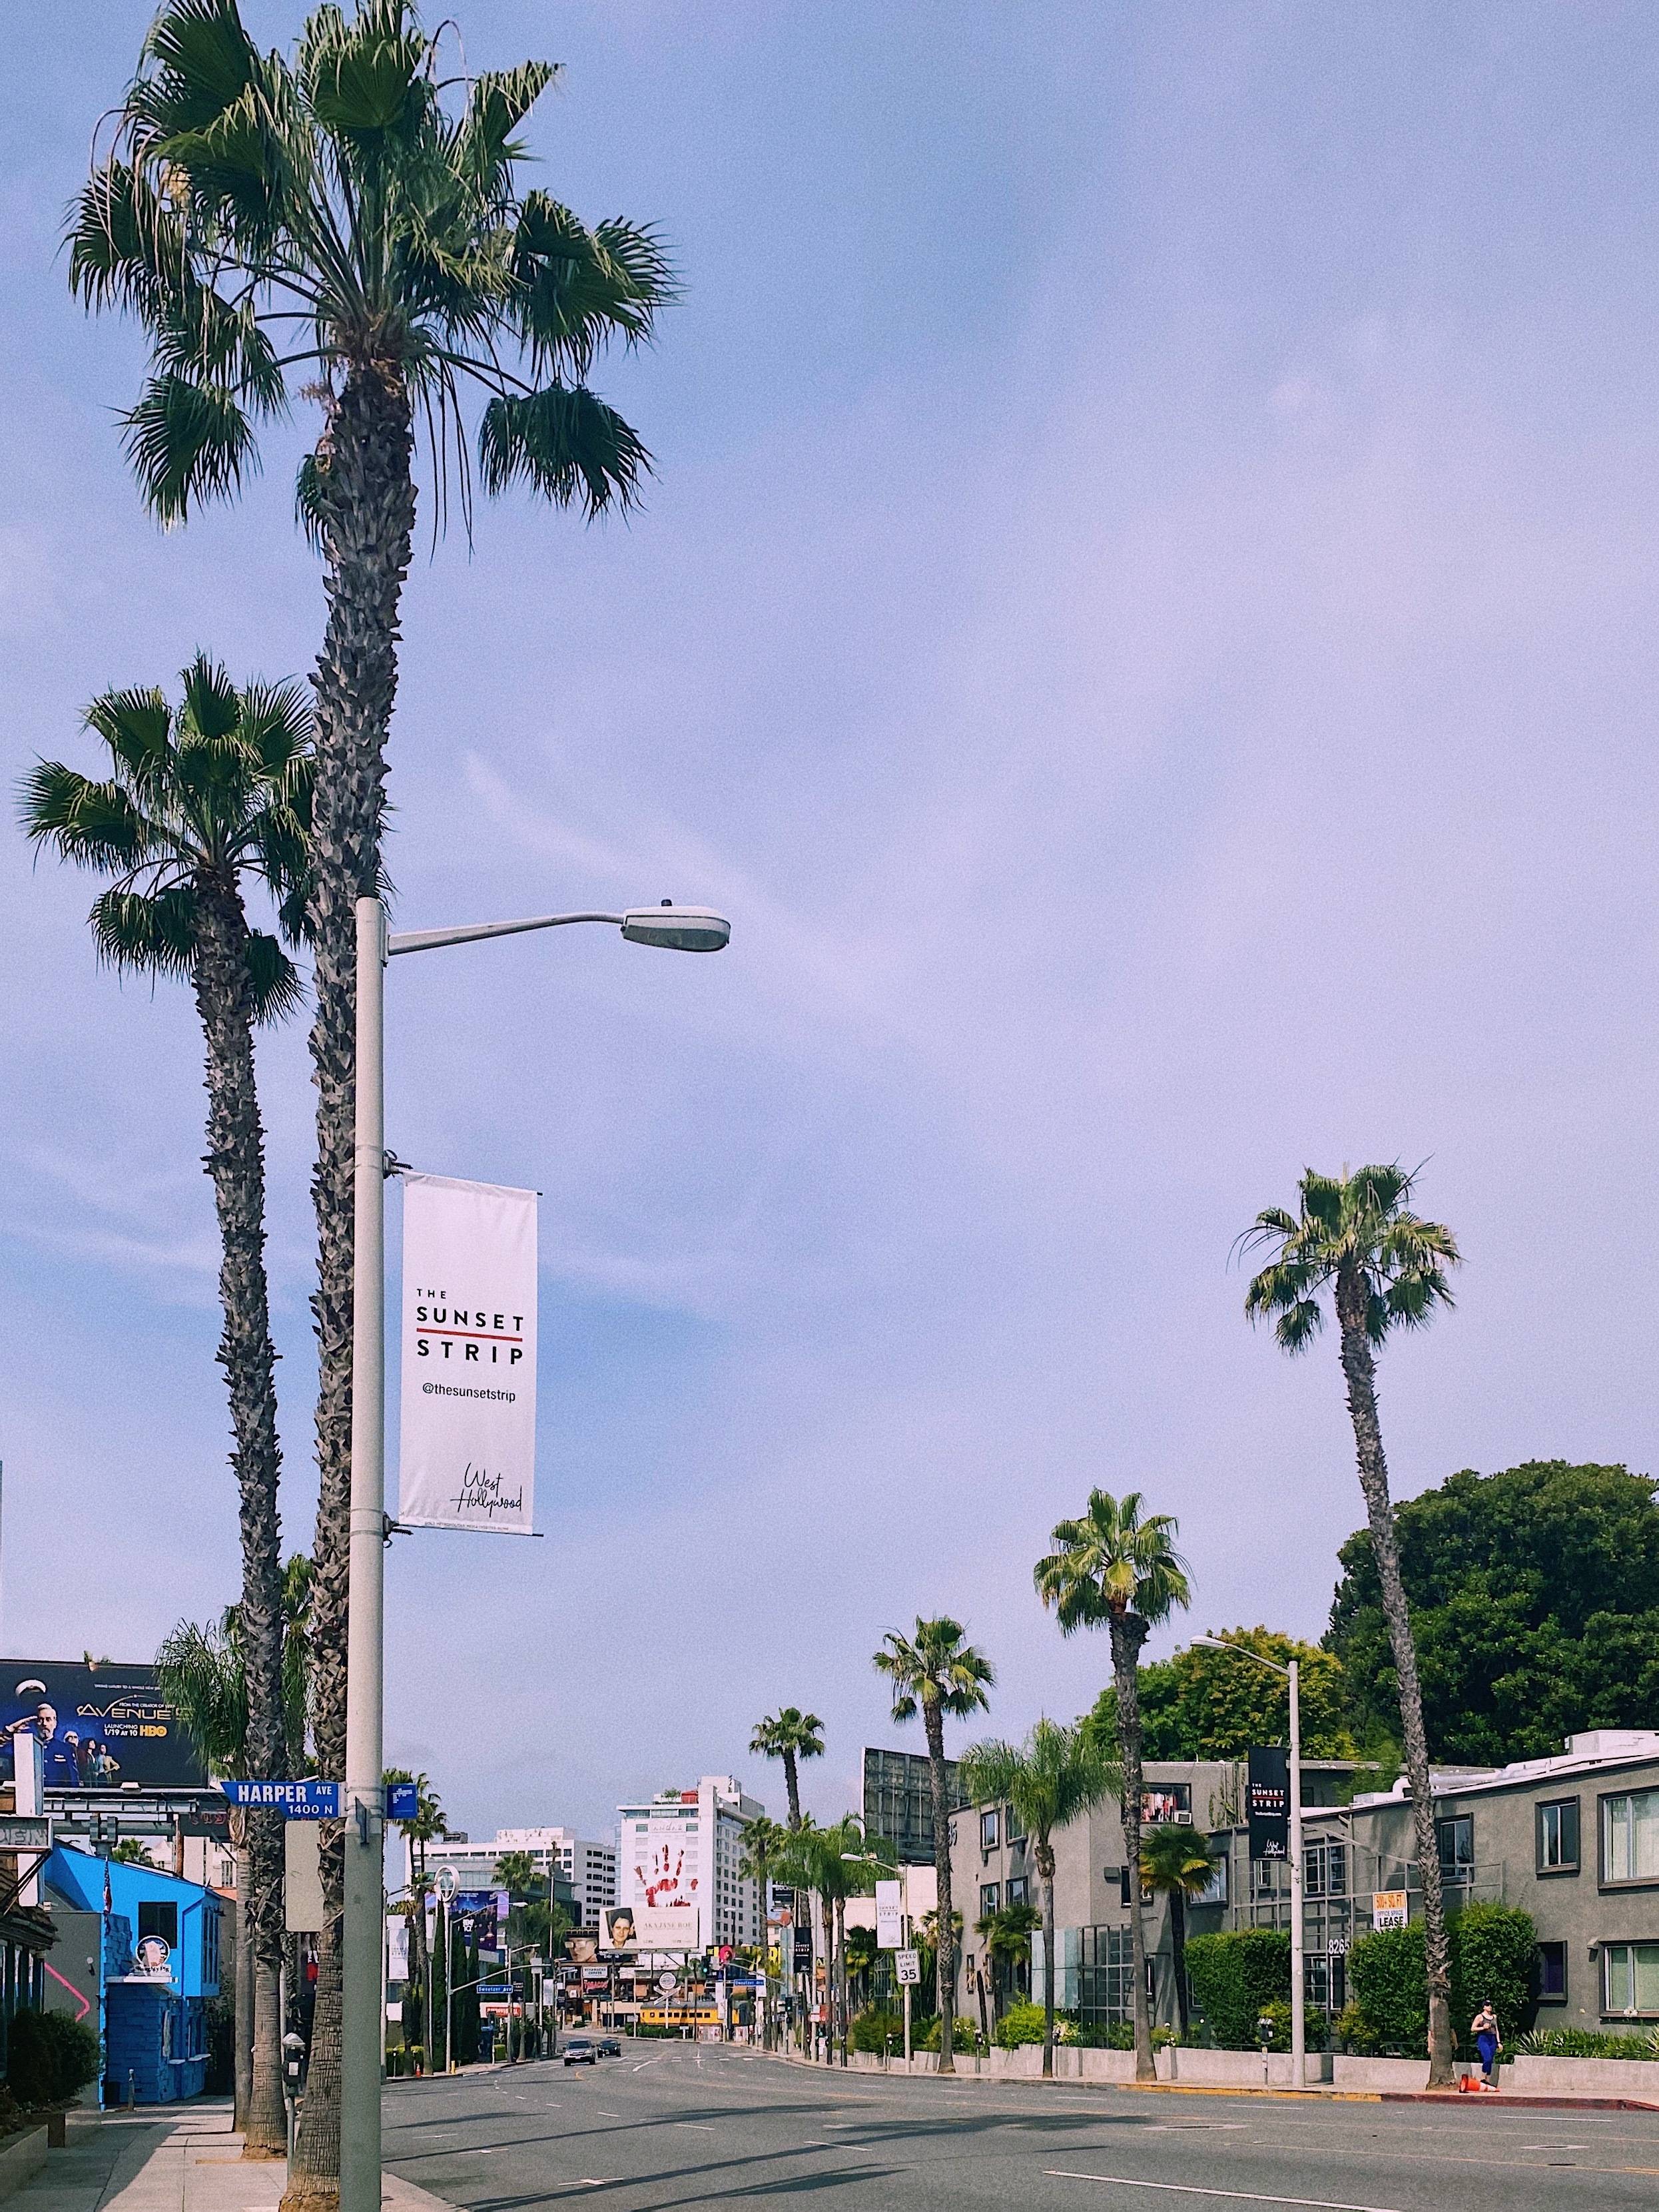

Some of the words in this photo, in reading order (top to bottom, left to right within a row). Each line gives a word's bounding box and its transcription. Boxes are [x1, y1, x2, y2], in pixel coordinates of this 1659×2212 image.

[417, 1288, 446, 1299] THE
[416, 1306, 523, 1331] SUNSET
[417, 1339, 523, 1365] STRIP
[422, 1382, 516, 1403] @thesunsetstrip
[464, 1462, 504, 1498] West
[450, 1485, 522, 1518] Hollywood
[77, 1703, 171, 1720] AVENUE
[140, 1724, 167, 1737] HBO
[238, 1784, 307, 1803] HARPER
[316, 1786, 332, 1796] AVE
[288, 1805, 320, 1814] 1400
[324, 1805, 333, 1814] N
[1380, 1916, 1403, 1927] LEASE
[1328, 1939, 1351, 1955] 8265
[901, 1969, 916, 1981] 35
